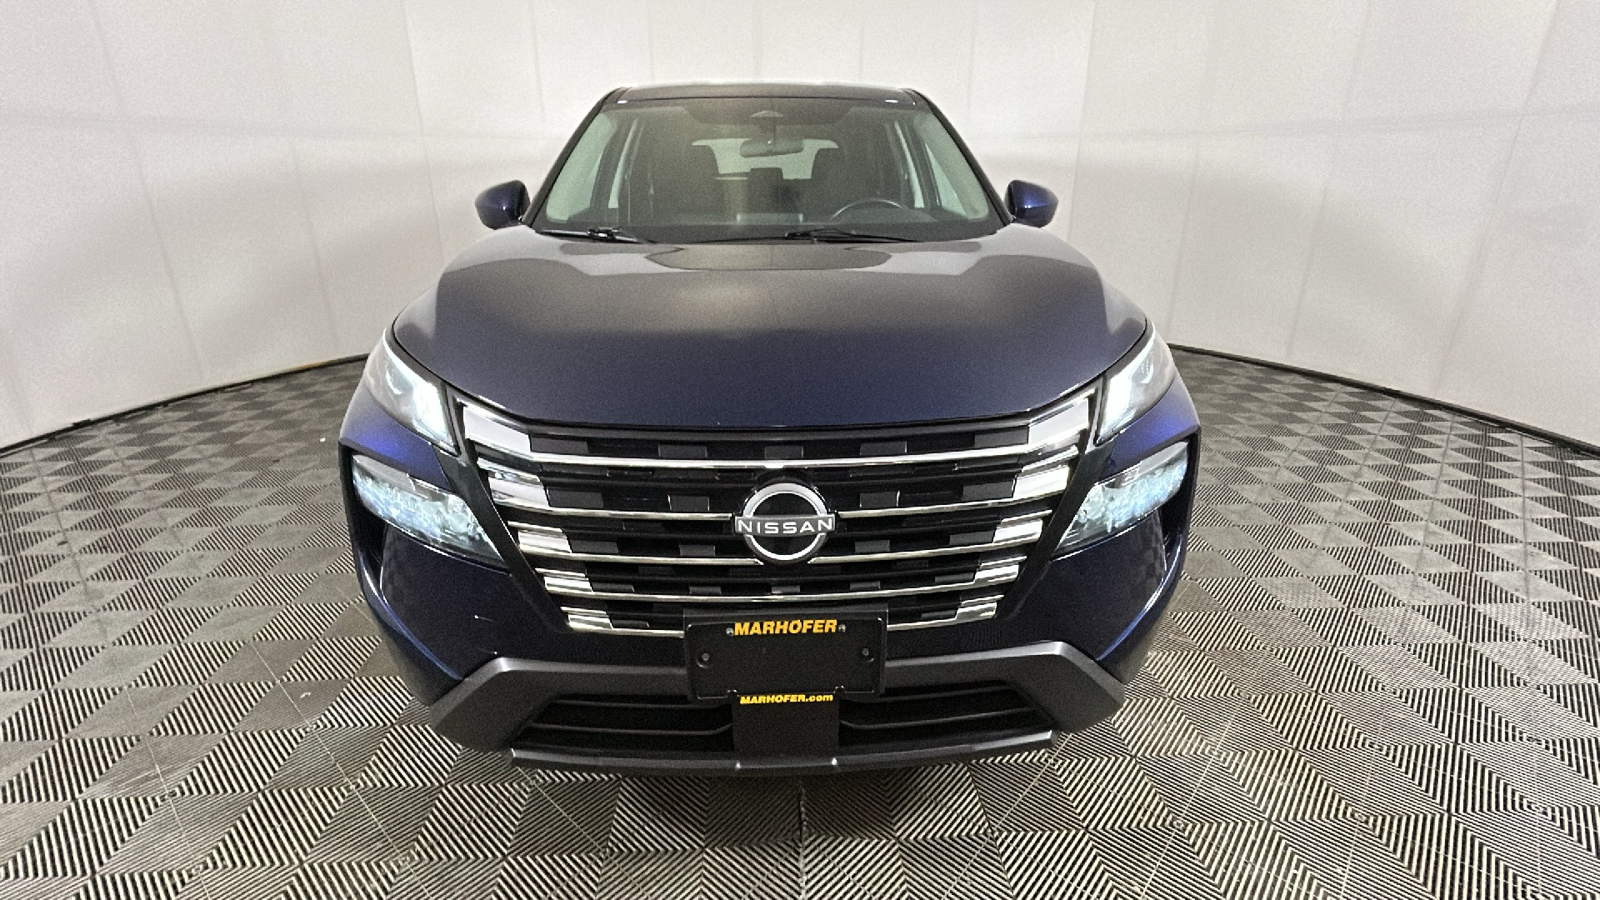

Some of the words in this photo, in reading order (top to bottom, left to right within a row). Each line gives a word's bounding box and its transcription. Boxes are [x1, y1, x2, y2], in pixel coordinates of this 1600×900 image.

[738, 518, 833, 534] NISSAN
[734, 619, 838, 636] MARHOFER
[740, 694, 834, 705] MARHOFER.com
